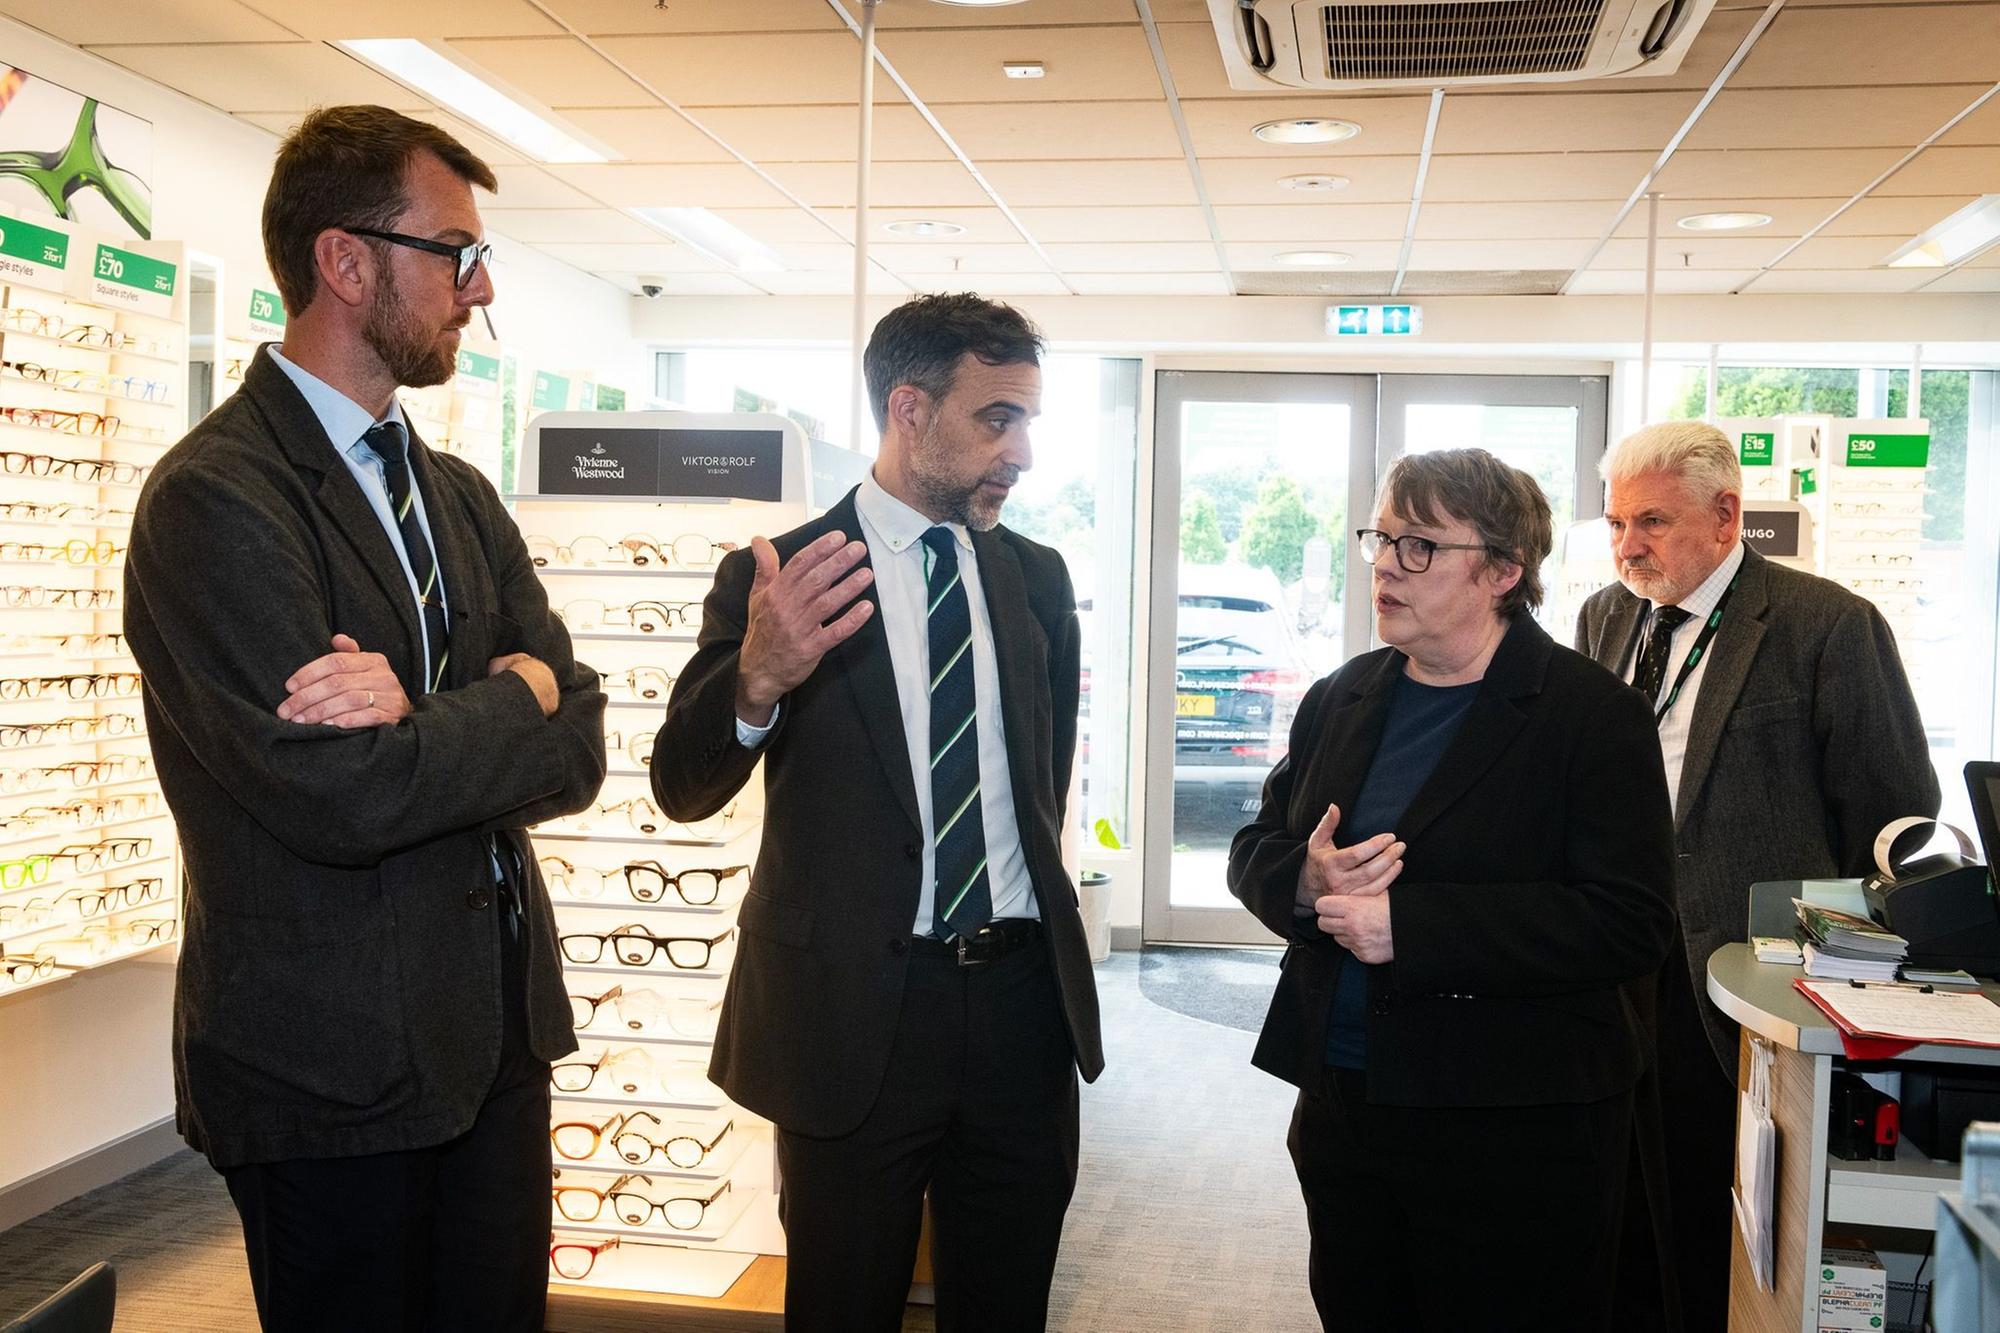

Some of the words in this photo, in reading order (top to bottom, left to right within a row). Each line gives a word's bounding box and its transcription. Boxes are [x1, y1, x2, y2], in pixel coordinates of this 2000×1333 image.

[11, 264, 34, 277] styles
[98, 257, 124, 279] £70
[96, 283, 119, 297] Square
[119, 288, 139, 302] styles
[253, 300, 273, 319] £70
[1744, 438, 1766, 450] £15
[1850, 439, 1876, 452] £50
[574, 455, 618, 467] Vivienne
[571, 466, 625, 479] Westwood
